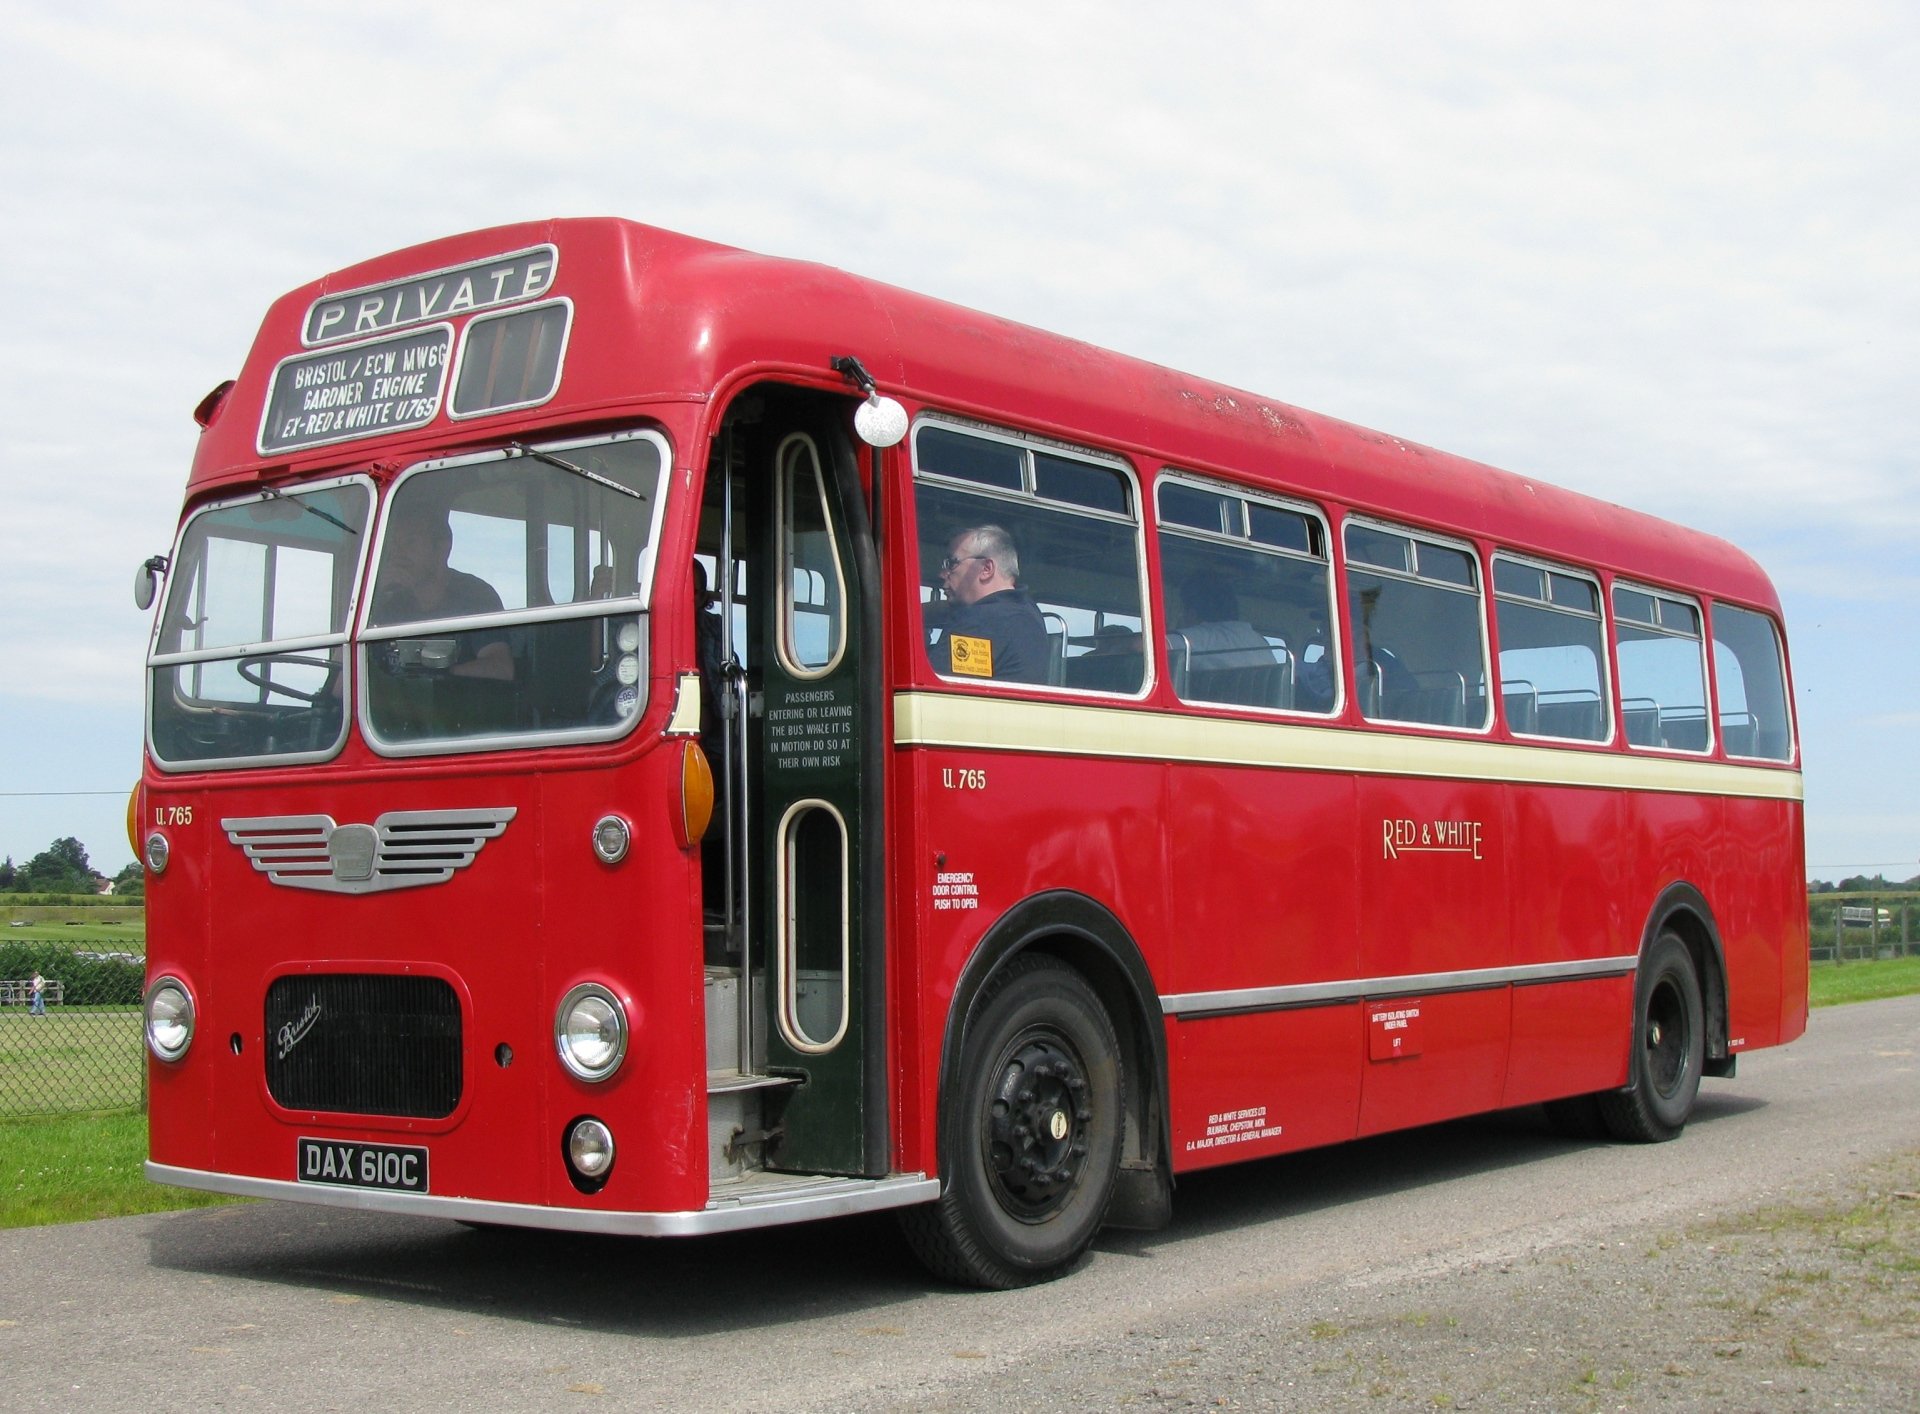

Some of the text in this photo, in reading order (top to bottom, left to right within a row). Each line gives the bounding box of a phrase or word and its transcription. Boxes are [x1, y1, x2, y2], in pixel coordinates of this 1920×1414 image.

[315, 261, 552, 339] PRIVATE
[295, 361, 347, 389] BRISTOL
[364, 352, 396, 377] ECW
[403, 343, 446, 372] MW6G
[303, 373, 427, 411] GARDNER ENGINE
[395, 396, 437, 421] U765
[785, 691, 835, 703] PASSENGERS
[769, 705, 852, 721] ENTERING OR LEAVING
[771, 722, 851, 737] THE BUS WHILE IT IS
[770, 739, 850, 753] IN MOTION DO SO AT
[778, 756, 841, 769] THEIR OWN RISK
[1383, 819, 1483, 860] RED & WHITE
[937, 872, 974, 884] EMERGENCY
[932, 884, 979, 896] DOOR CONTROL
[934, 898, 978, 910] PUSH TO OPEN
[277, 993, 321, 1060] Bristol
[1208, 1115, 1219, 1125] RED
[1223, 1111, 1237, 1121] WHITE
[1237, 1108, 1257, 1119] SERVICES
[1214, 1134, 1237, 1146] DIRECTOR
[1261, 1126, 1283, 1138] MANAGER
[306, 1144, 419, 1187] DAX 610C
